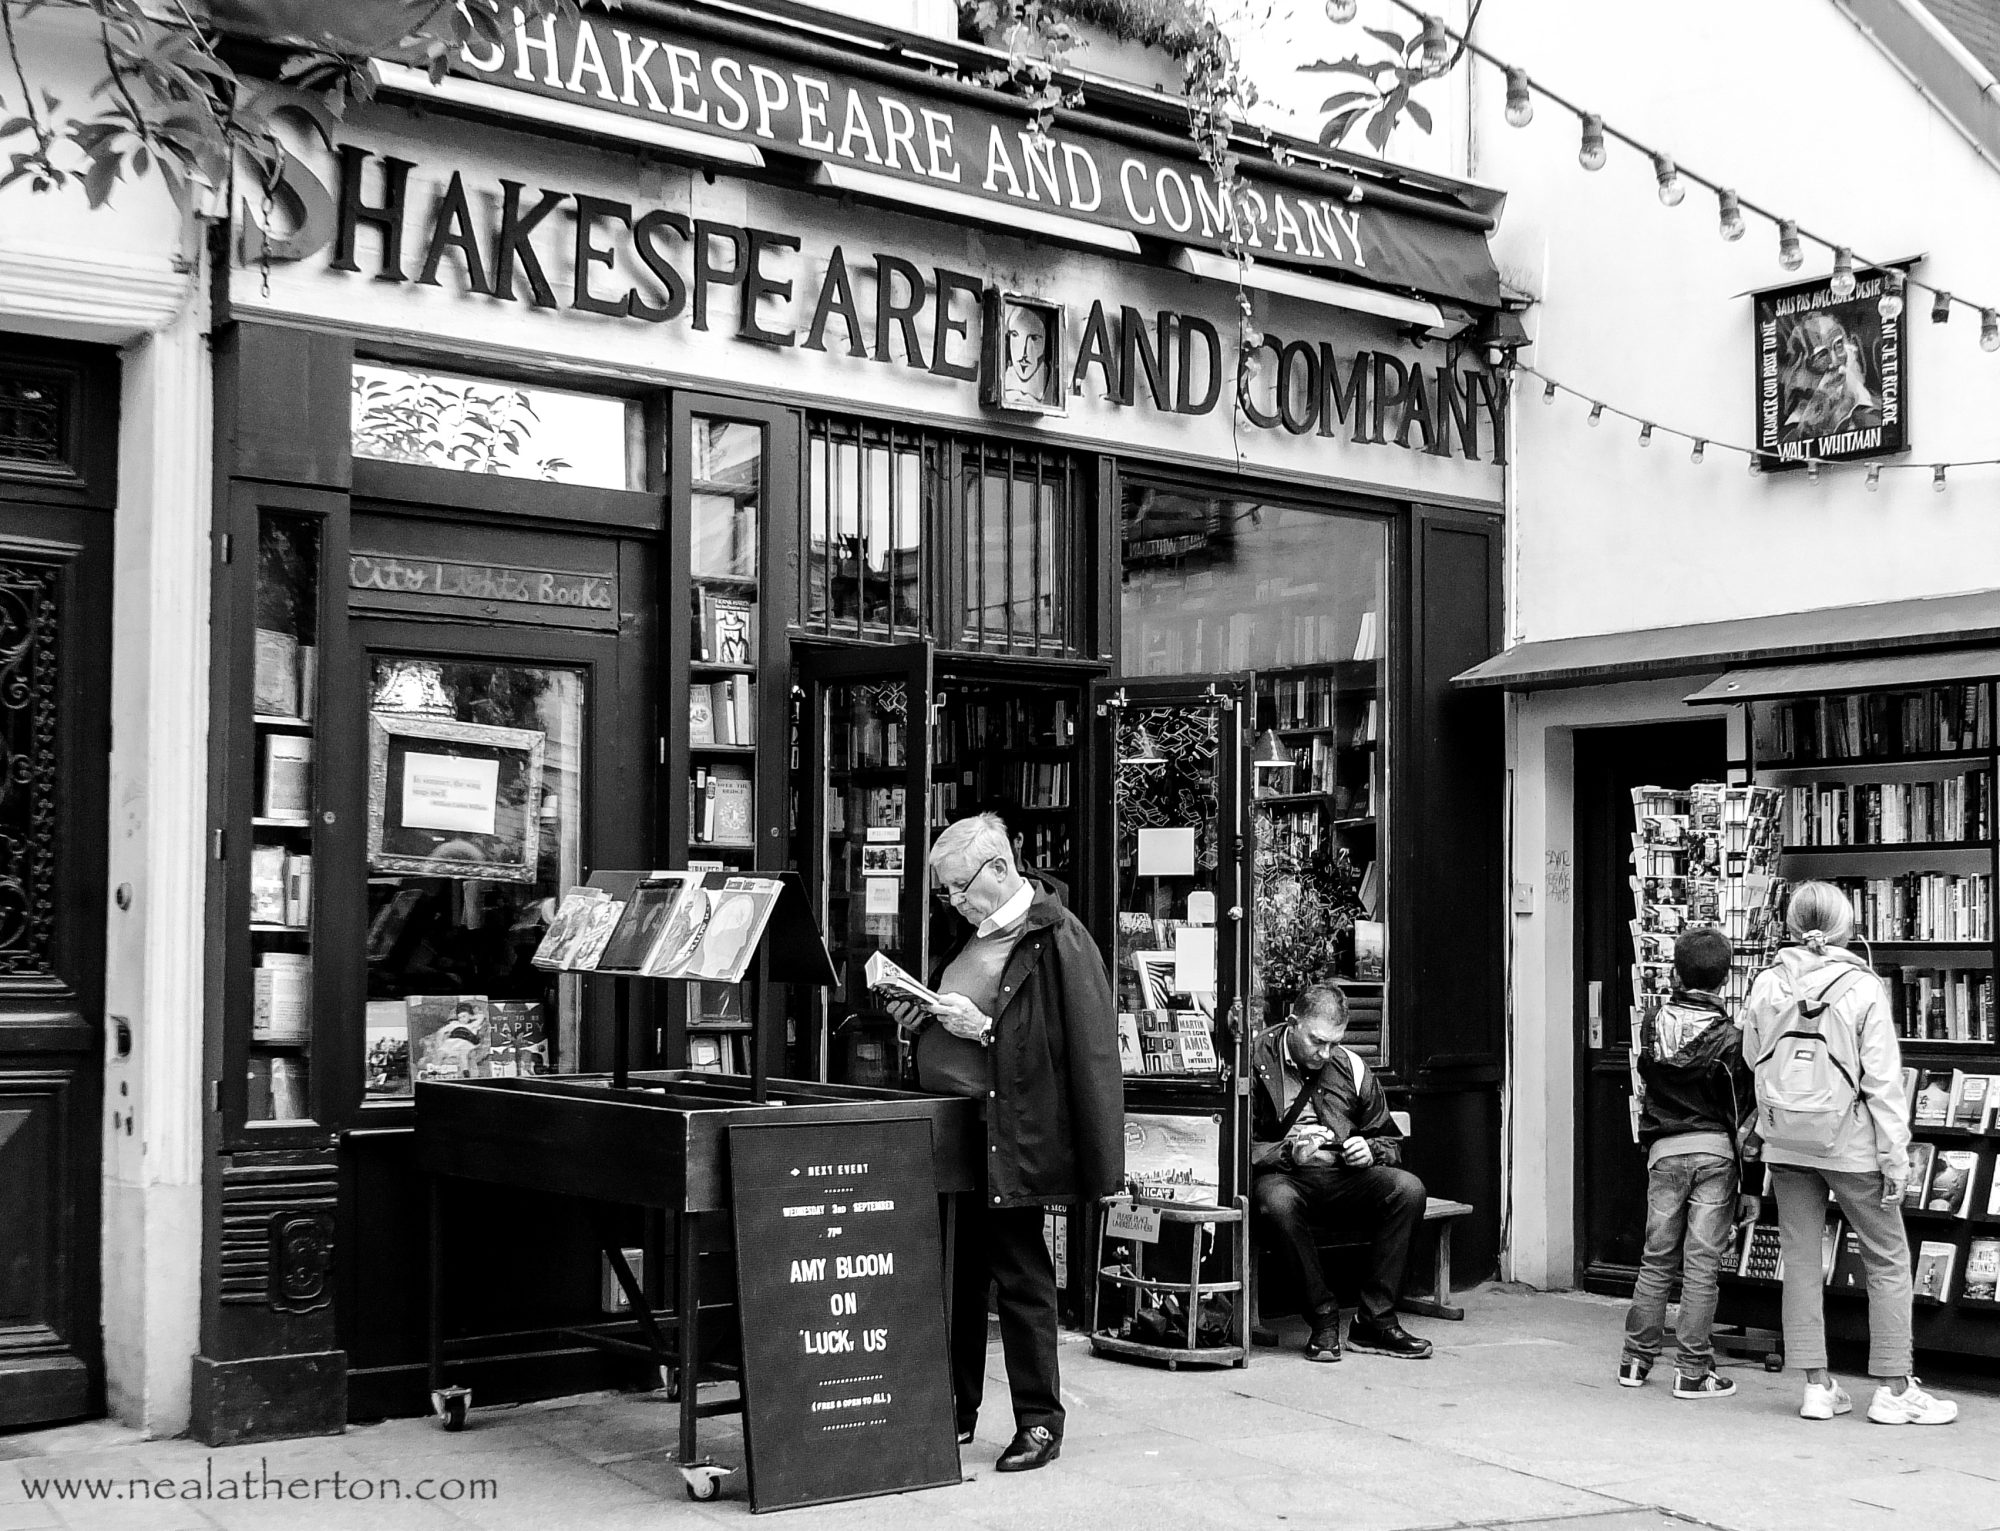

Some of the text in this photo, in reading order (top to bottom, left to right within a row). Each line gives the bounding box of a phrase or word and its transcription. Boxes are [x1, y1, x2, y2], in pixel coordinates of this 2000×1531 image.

[983, 125, 1101, 212] AND
[1120, 158, 1366, 268] COMPANY
[240, 104, 1514, 466] SHAKESPEARE AND COMPANY
[1762, 335, 1777, 352] TU
[1763, 351, 1778, 378] PASSE
[1763, 378, 1778, 398] QUI
[1777, 427, 1881, 463] WALT WHITMAN
[488, 1022, 544, 1033] HAPPY
[1179, 1019, 1205, 1030] MARTIN
[1184, 1037, 1210, 1050] AMIS
[808, 1163, 869, 1177] NEXT EVENT
[782, 1204, 825, 1218] WEDNESDAY
[853, 1200, 895, 1213] SEPTEMBER
[790, 1252, 894, 1284] AMY BLOOM
[830, 1291, 857, 1317] ON
